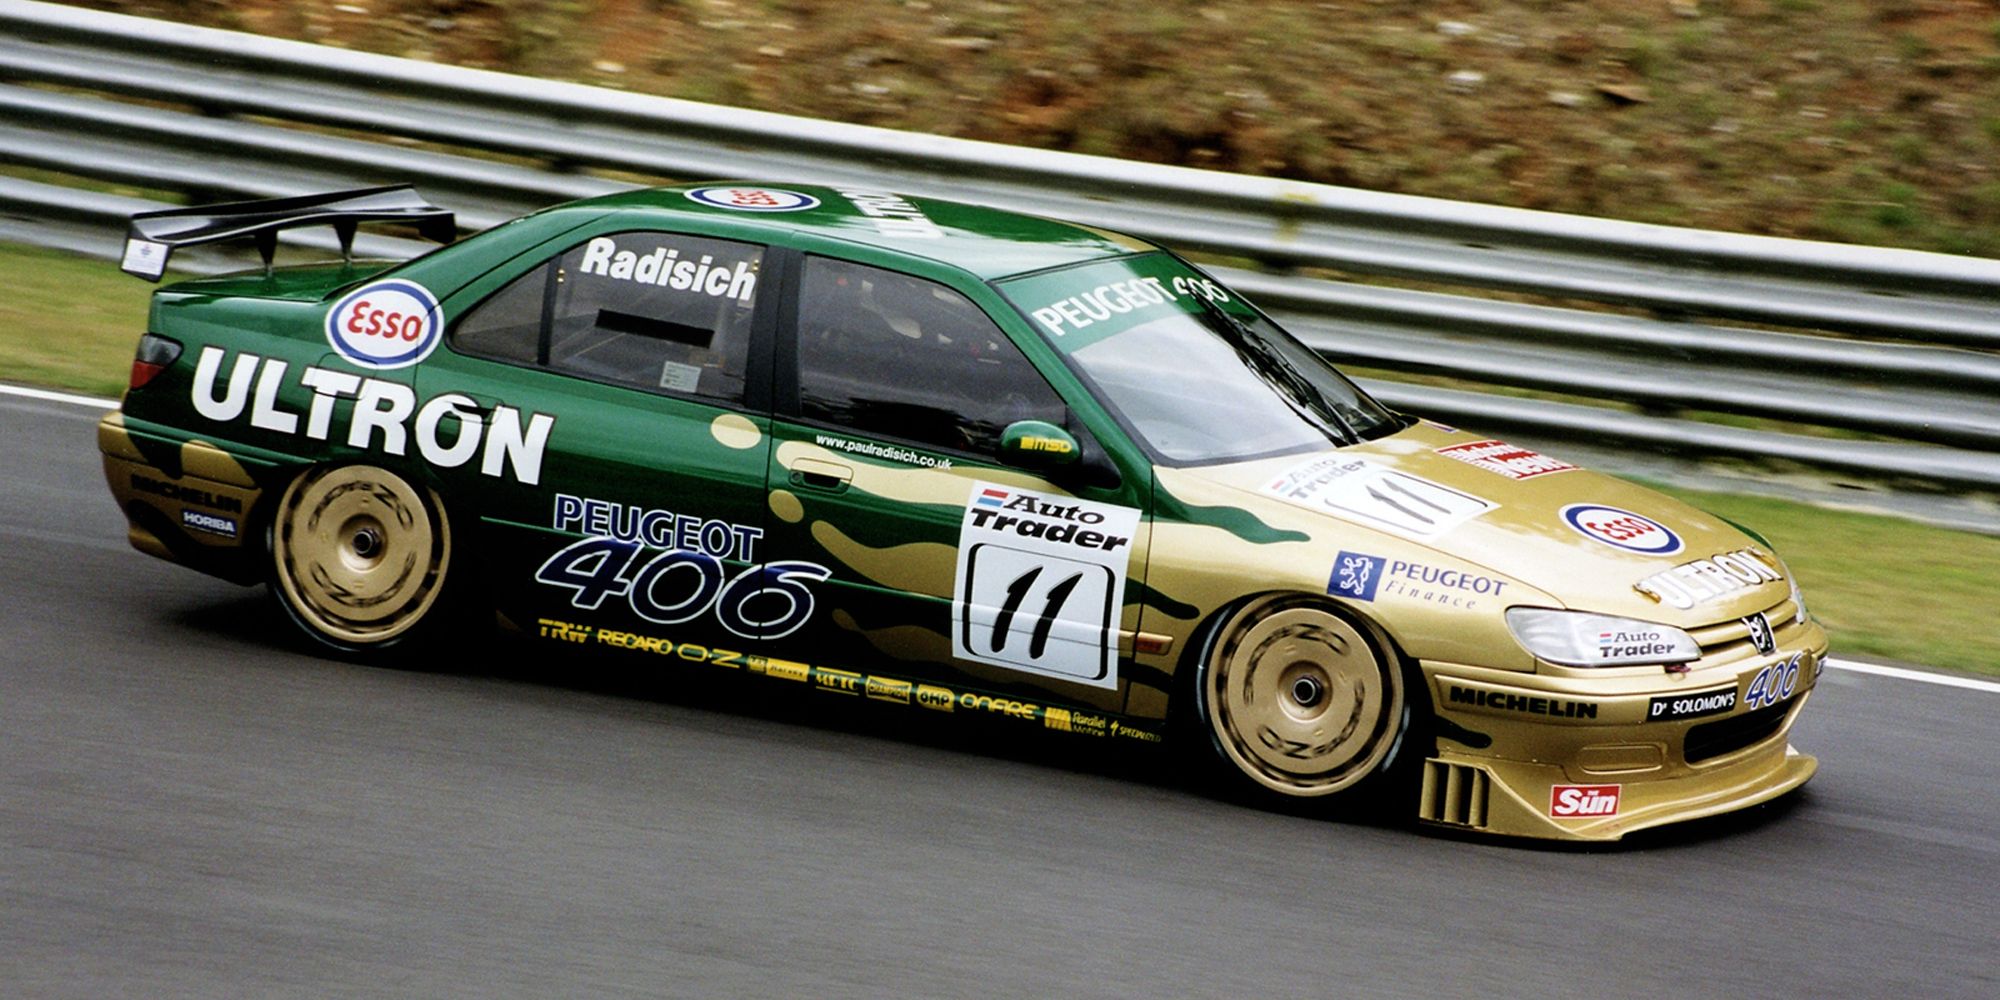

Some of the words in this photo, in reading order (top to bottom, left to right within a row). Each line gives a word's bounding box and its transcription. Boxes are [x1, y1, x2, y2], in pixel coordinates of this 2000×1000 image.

[579, 236, 757, 301] Radisich
[1031, 276, 1178, 337] PEUGEOT
[191, 345, 556, 487] ULTRON
[815, 434, 953, 471] www.paulradisich.co.uk
[1288, 460, 1370, 499] Trader
[1003, 494, 1106, 525] Auto
[1364, 477, 1453, 525] 11
[183, 511, 237, 533] HORIBA
[553, 493, 764, 563] PEUGEOT
[970, 507, 1129, 552] Trader
[535, 535, 833, 640] 406
[1385, 579, 1477, 610] Finance
[1390, 560, 1509, 597] PEUGEOT
[1636, 546, 1784, 610] ULTRON
[538, 617, 592, 644] TRW
[990, 565, 1084, 660] 11
[597, 628, 673, 655] RECARO
[1599, 642, 1676, 659] Trader
[1613, 631, 1661, 644] Auto
[920, 690, 950, 706] OMP
[1744, 650, 1805, 712] 406
[1450, 685, 1599, 720] MICHELIN
[1672, 691, 1736, 715] SOLOMON'S
[1553, 788, 1617, 815] Sun
